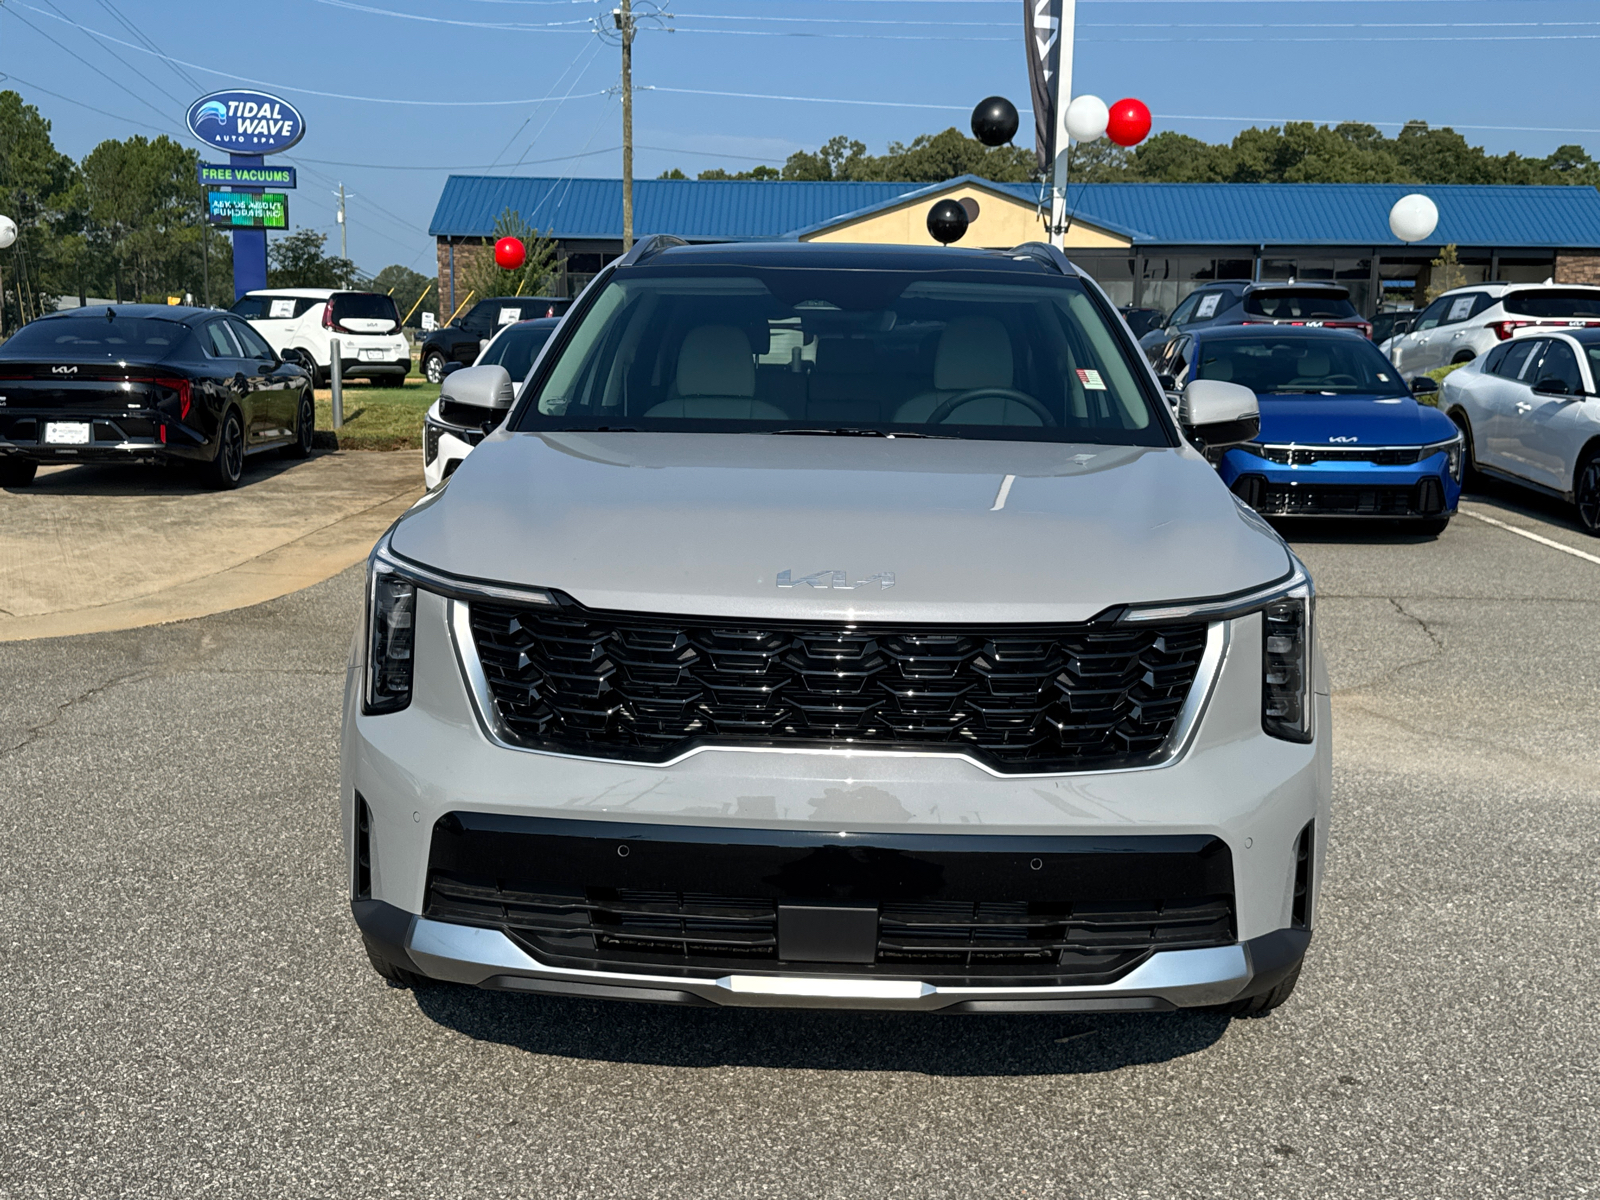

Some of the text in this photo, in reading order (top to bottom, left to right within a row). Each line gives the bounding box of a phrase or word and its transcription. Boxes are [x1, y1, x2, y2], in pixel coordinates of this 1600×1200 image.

[227, 101, 282, 119] TIDAL
[236, 119, 293, 136] WAVE
[202, 168, 290, 182] FREE VACUUMS
[51, 365, 78, 374] KIA
[1328, 435, 1358, 443] KIA
[776, 568, 895, 591] KIA
